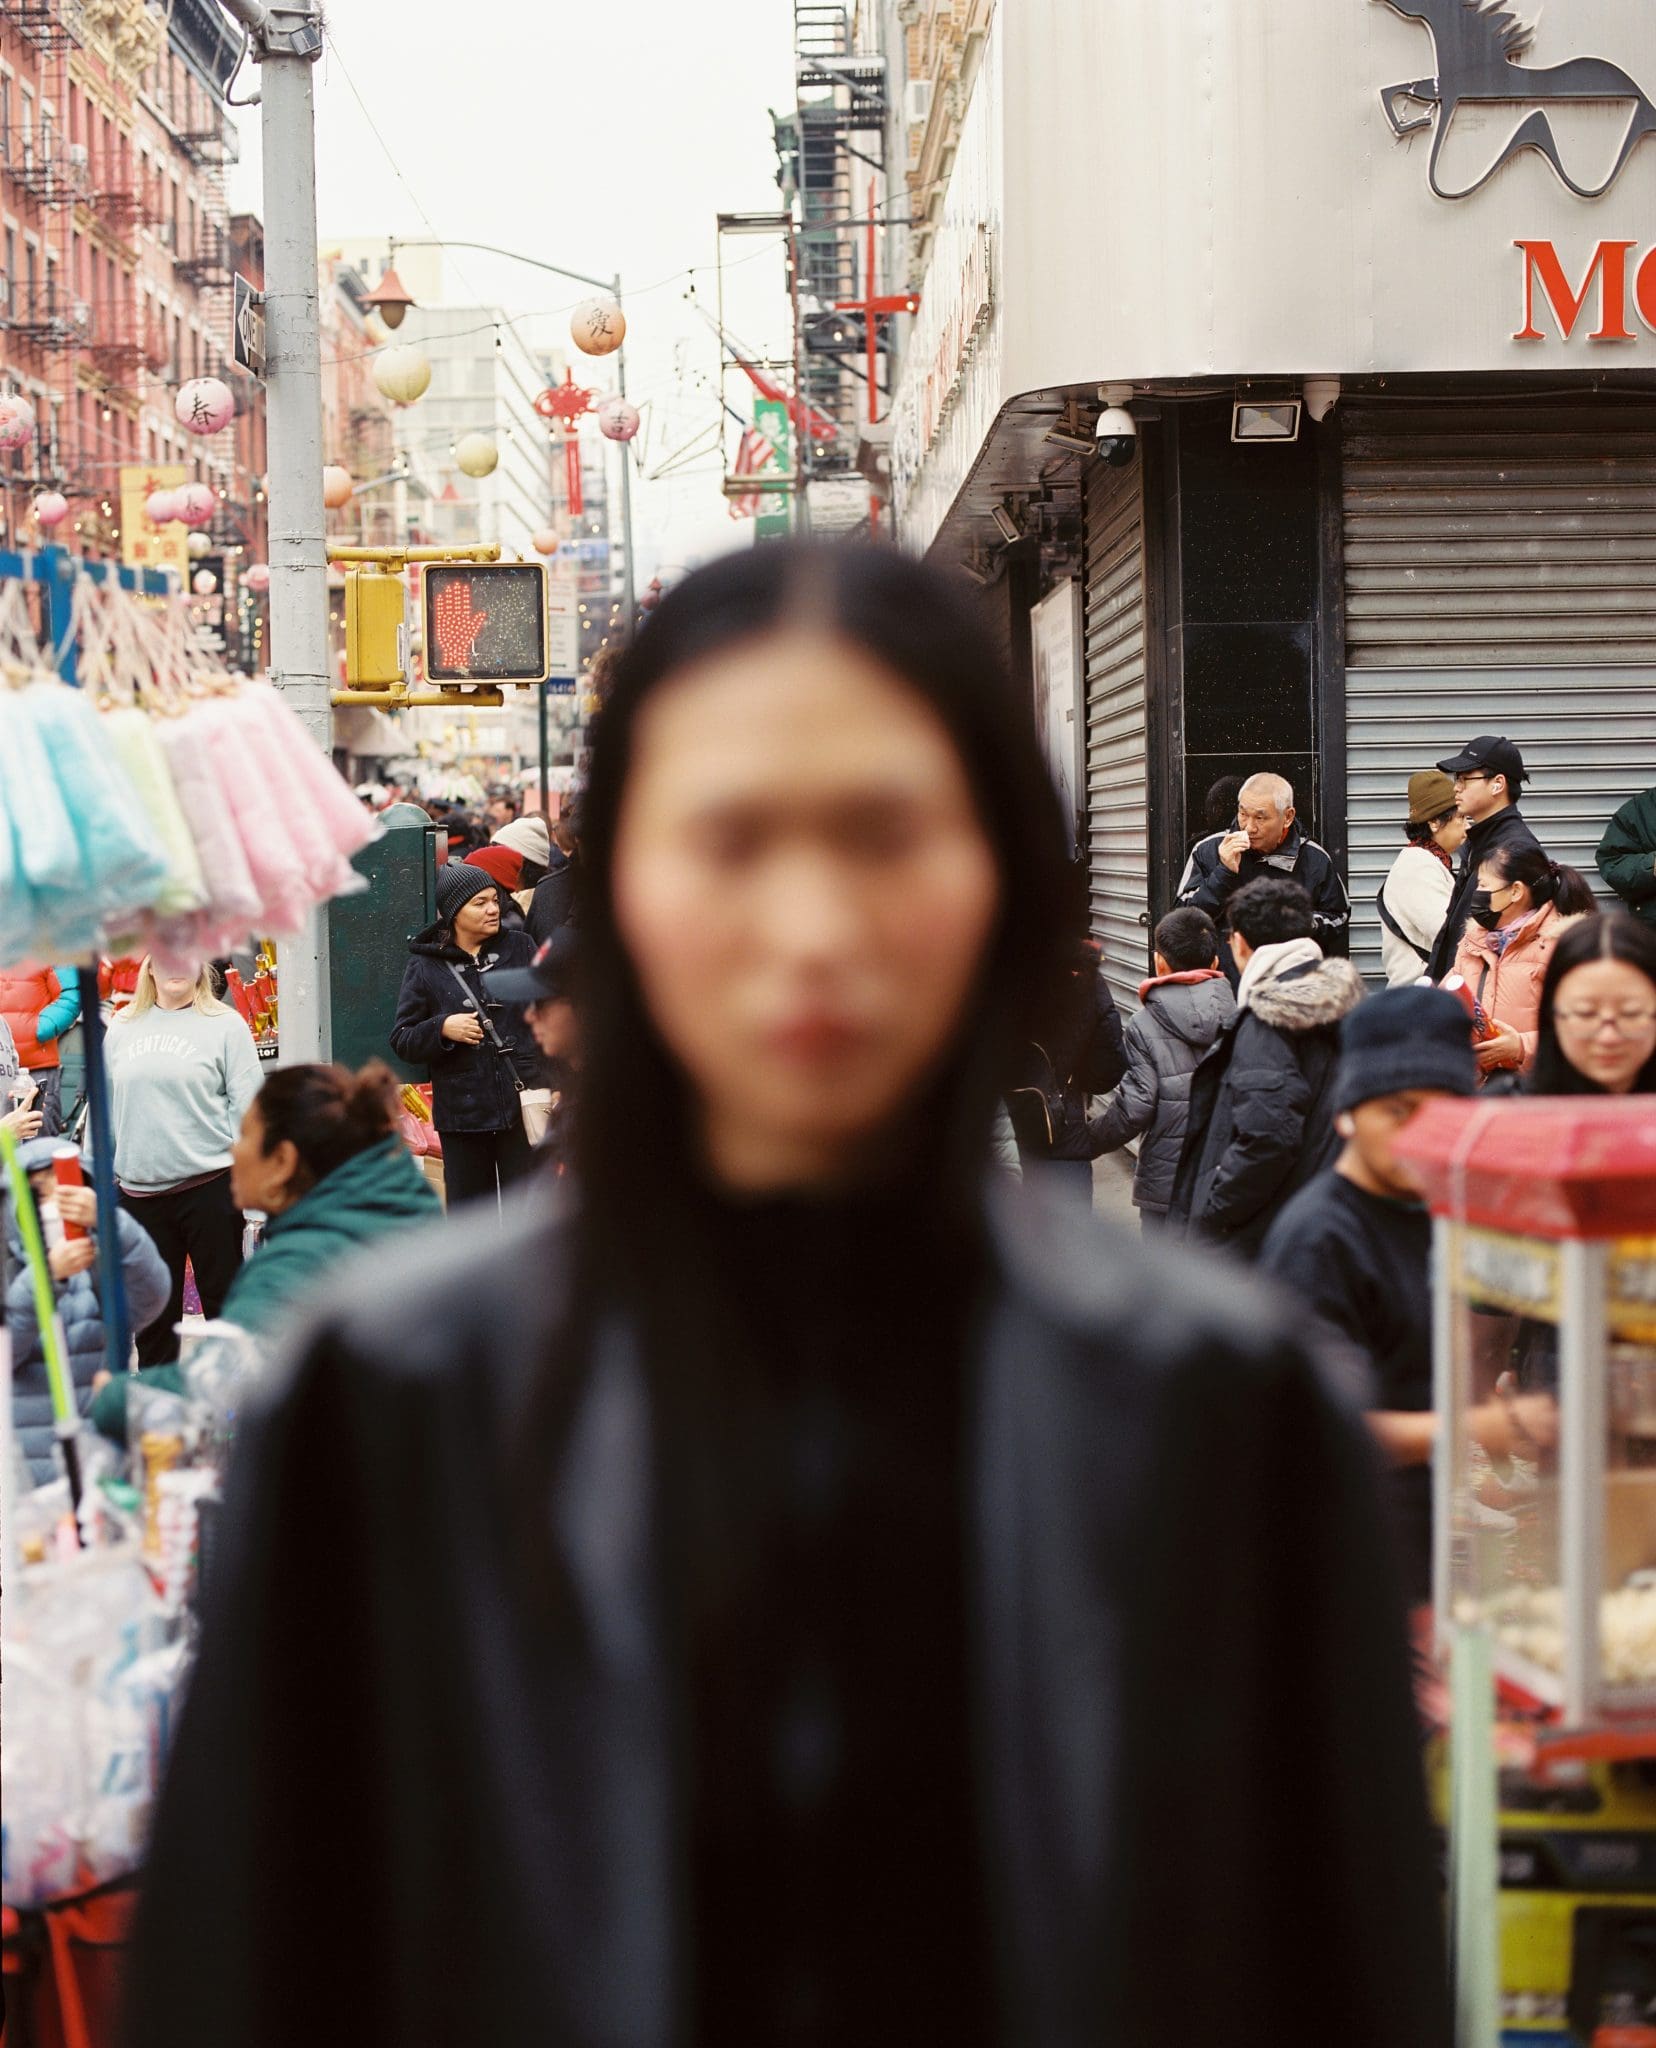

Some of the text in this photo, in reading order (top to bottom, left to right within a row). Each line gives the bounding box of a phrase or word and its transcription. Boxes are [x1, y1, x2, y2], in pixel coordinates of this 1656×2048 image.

[1511, 240, 1656, 340] M
[190, 392, 218, 426] 春
[127, 1033, 199, 1061] KENTUCKY
